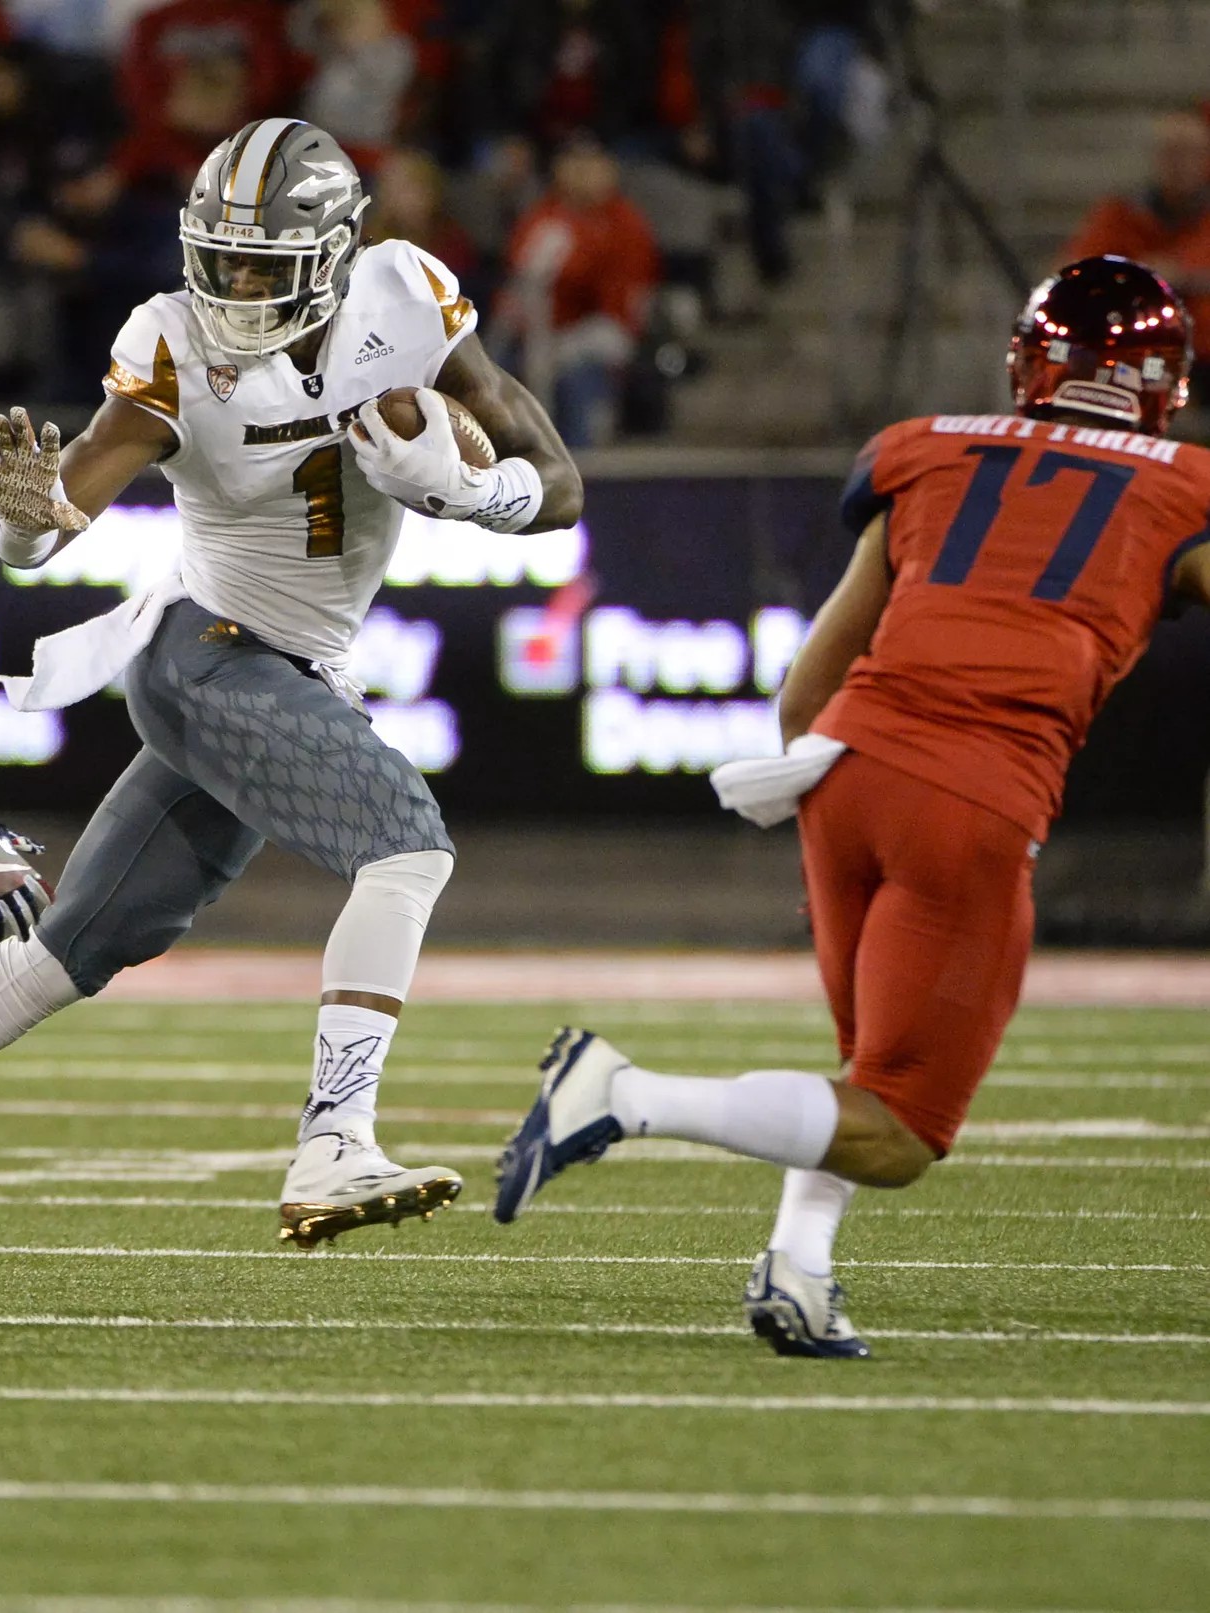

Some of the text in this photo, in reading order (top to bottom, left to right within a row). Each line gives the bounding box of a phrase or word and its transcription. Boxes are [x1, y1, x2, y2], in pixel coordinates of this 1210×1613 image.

[216, 381, 232, 395] 12
[354, 345, 395, 365] adidas
[292, 443, 345, 558] 1
[928, 444, 1137, 602] 17
